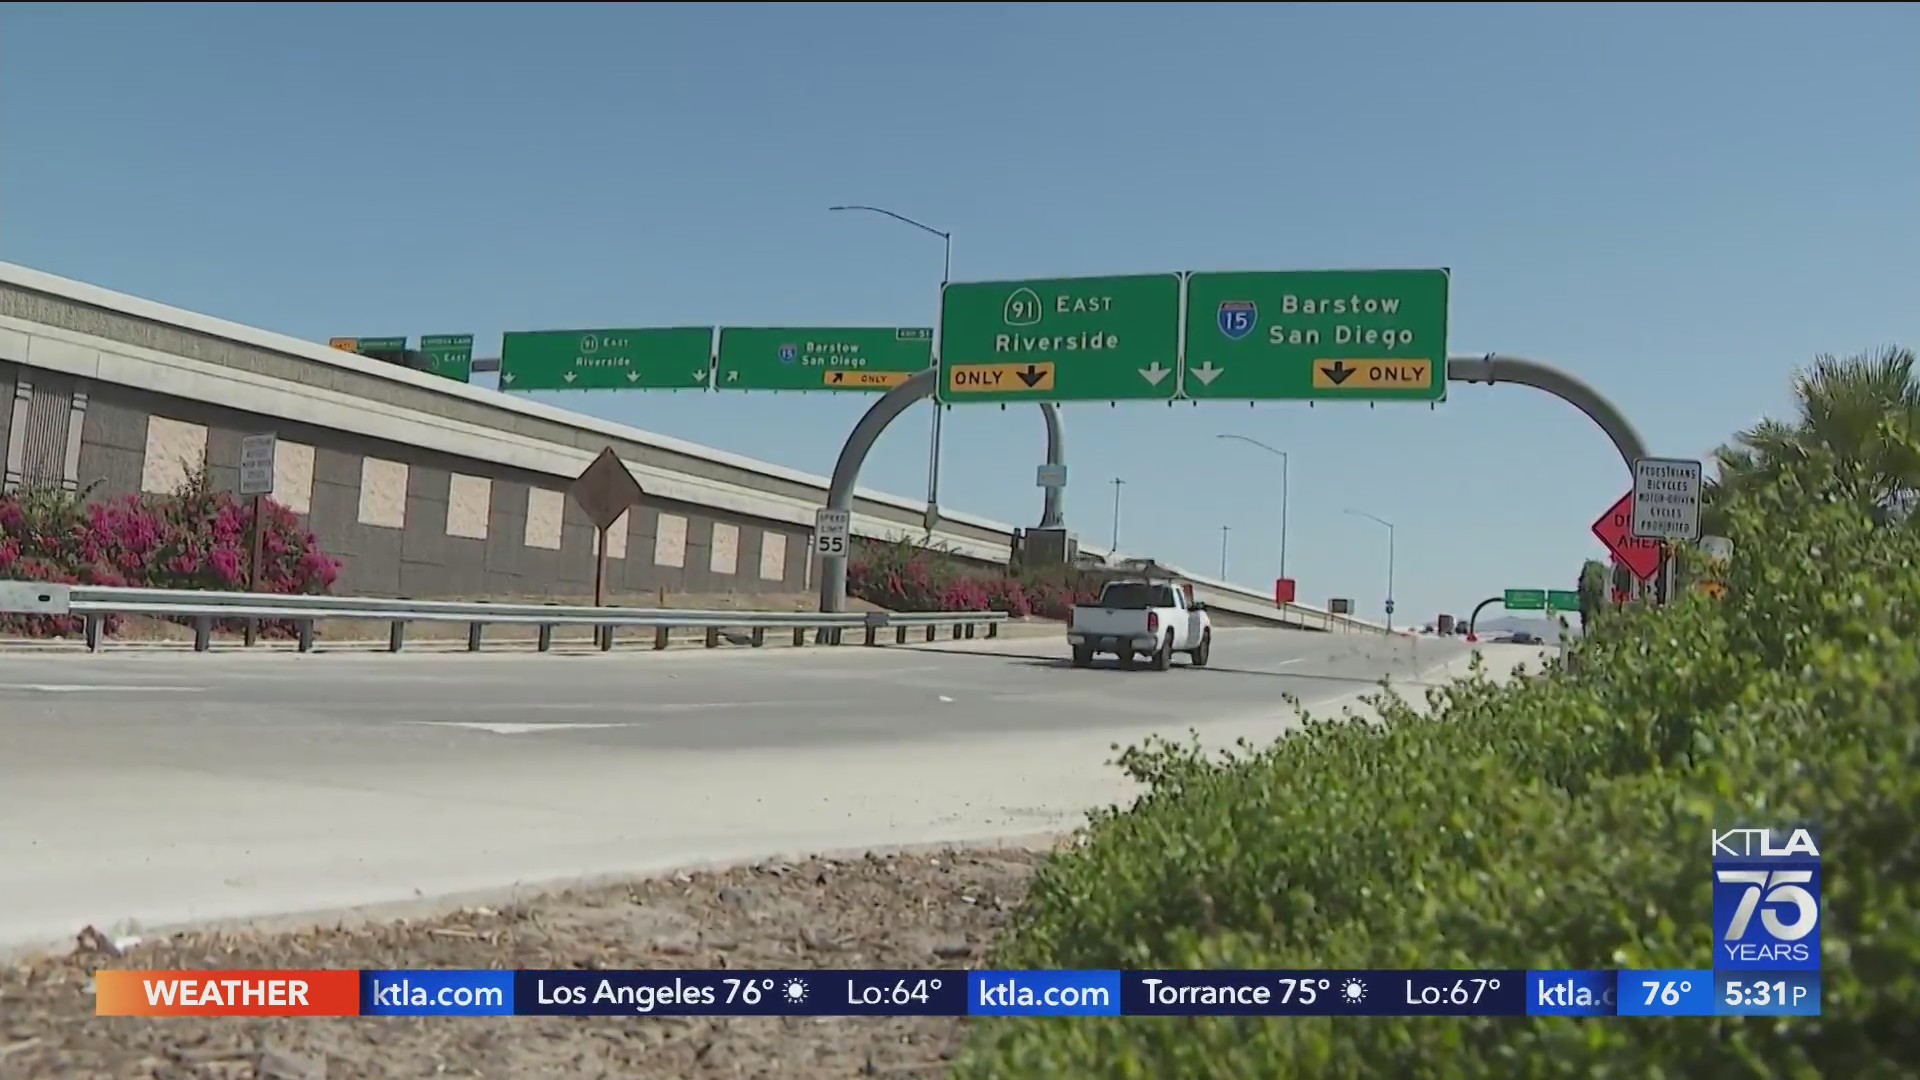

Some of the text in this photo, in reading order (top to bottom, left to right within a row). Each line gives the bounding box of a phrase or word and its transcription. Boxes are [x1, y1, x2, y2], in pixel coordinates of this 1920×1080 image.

[1012, 296, 1112, 318] 91 EAST
[1282, 295, 1400, 314] Barstow
[1224, 312, 1248, 330] 15
[584, 337, 629, 350] 91 EAST
[996, 331, 1119, 352] Riverside
[1269, 325, 1413, 349] San Diego
[782, 341, 860, 359] 15 Barstow
[576, 356, 631, 367] Riverside
[802, 355, 866, 367] San Diego
[861, 375, 888, 383] ONLY
[955, 371, 1004, 385] ONLY
[1369, 367, 1425, 381] ONLY
[1640, 466, 1696, 479] PEDESTRIANS
[1647, 481, 1687, 492] BICYCLES
[1650, 507, 1681, 518] CYCLES
[819, 536, 843, 552] 55
[1617, 535, 1660, 549] AHEA
